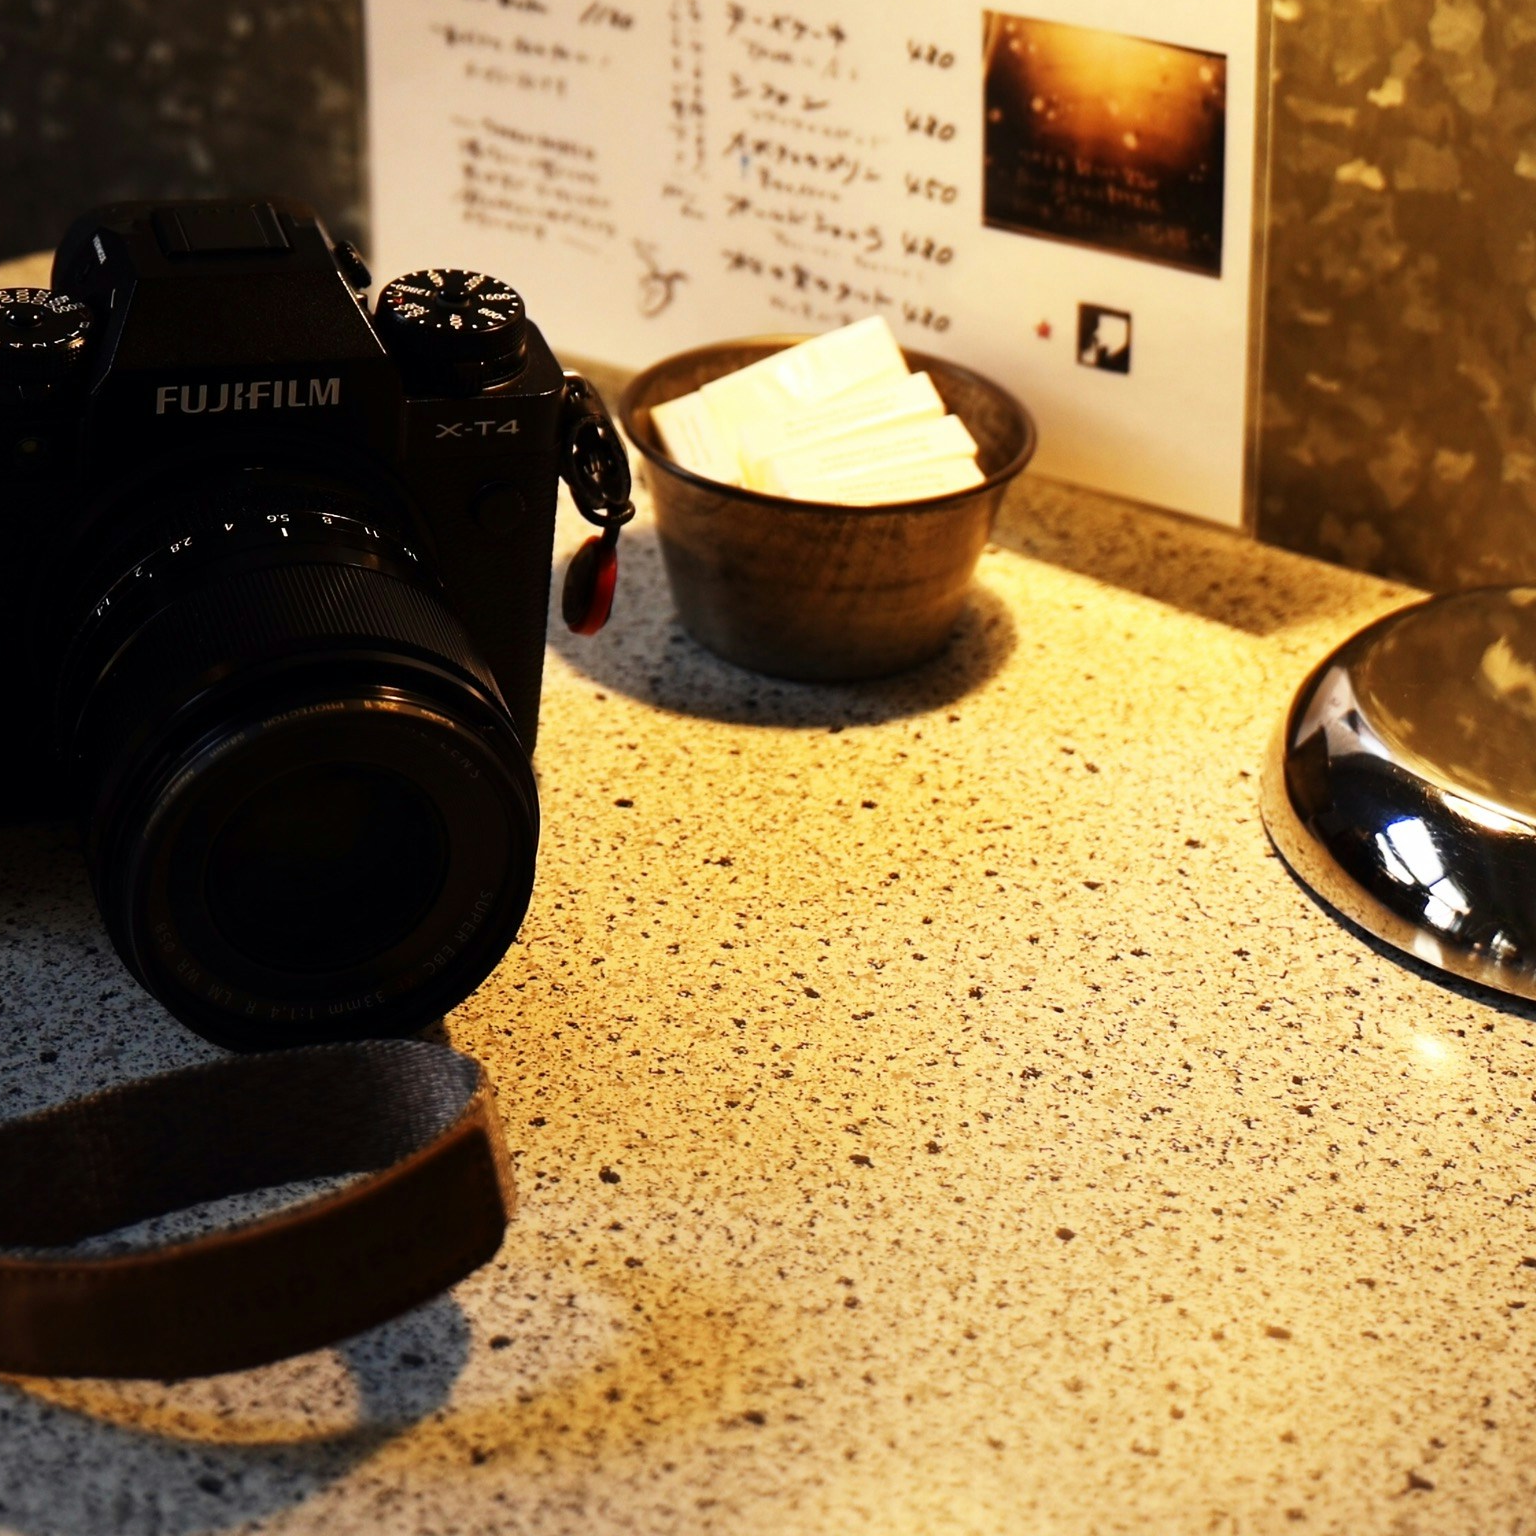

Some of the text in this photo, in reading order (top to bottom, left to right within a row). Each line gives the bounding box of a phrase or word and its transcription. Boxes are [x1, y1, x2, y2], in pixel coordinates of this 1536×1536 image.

[478, 293, 511, 301] 1600
[155, 377, 342, 415] FUJIFILM
[435, 419, 521, 439] X-T4
[169, 536, 193, 555] 2.8
[266, 513, 290, 524] 5.6
[261, 701, 345, 729] PROTECTOR
[454, 889, 494, 943] SUPER
[175, 957, 201, 984] WR
[422, 944, 456, 976] EBC
[207, 983, 233, 1007] LM
[327, 989, 386, 1015] 33mm
